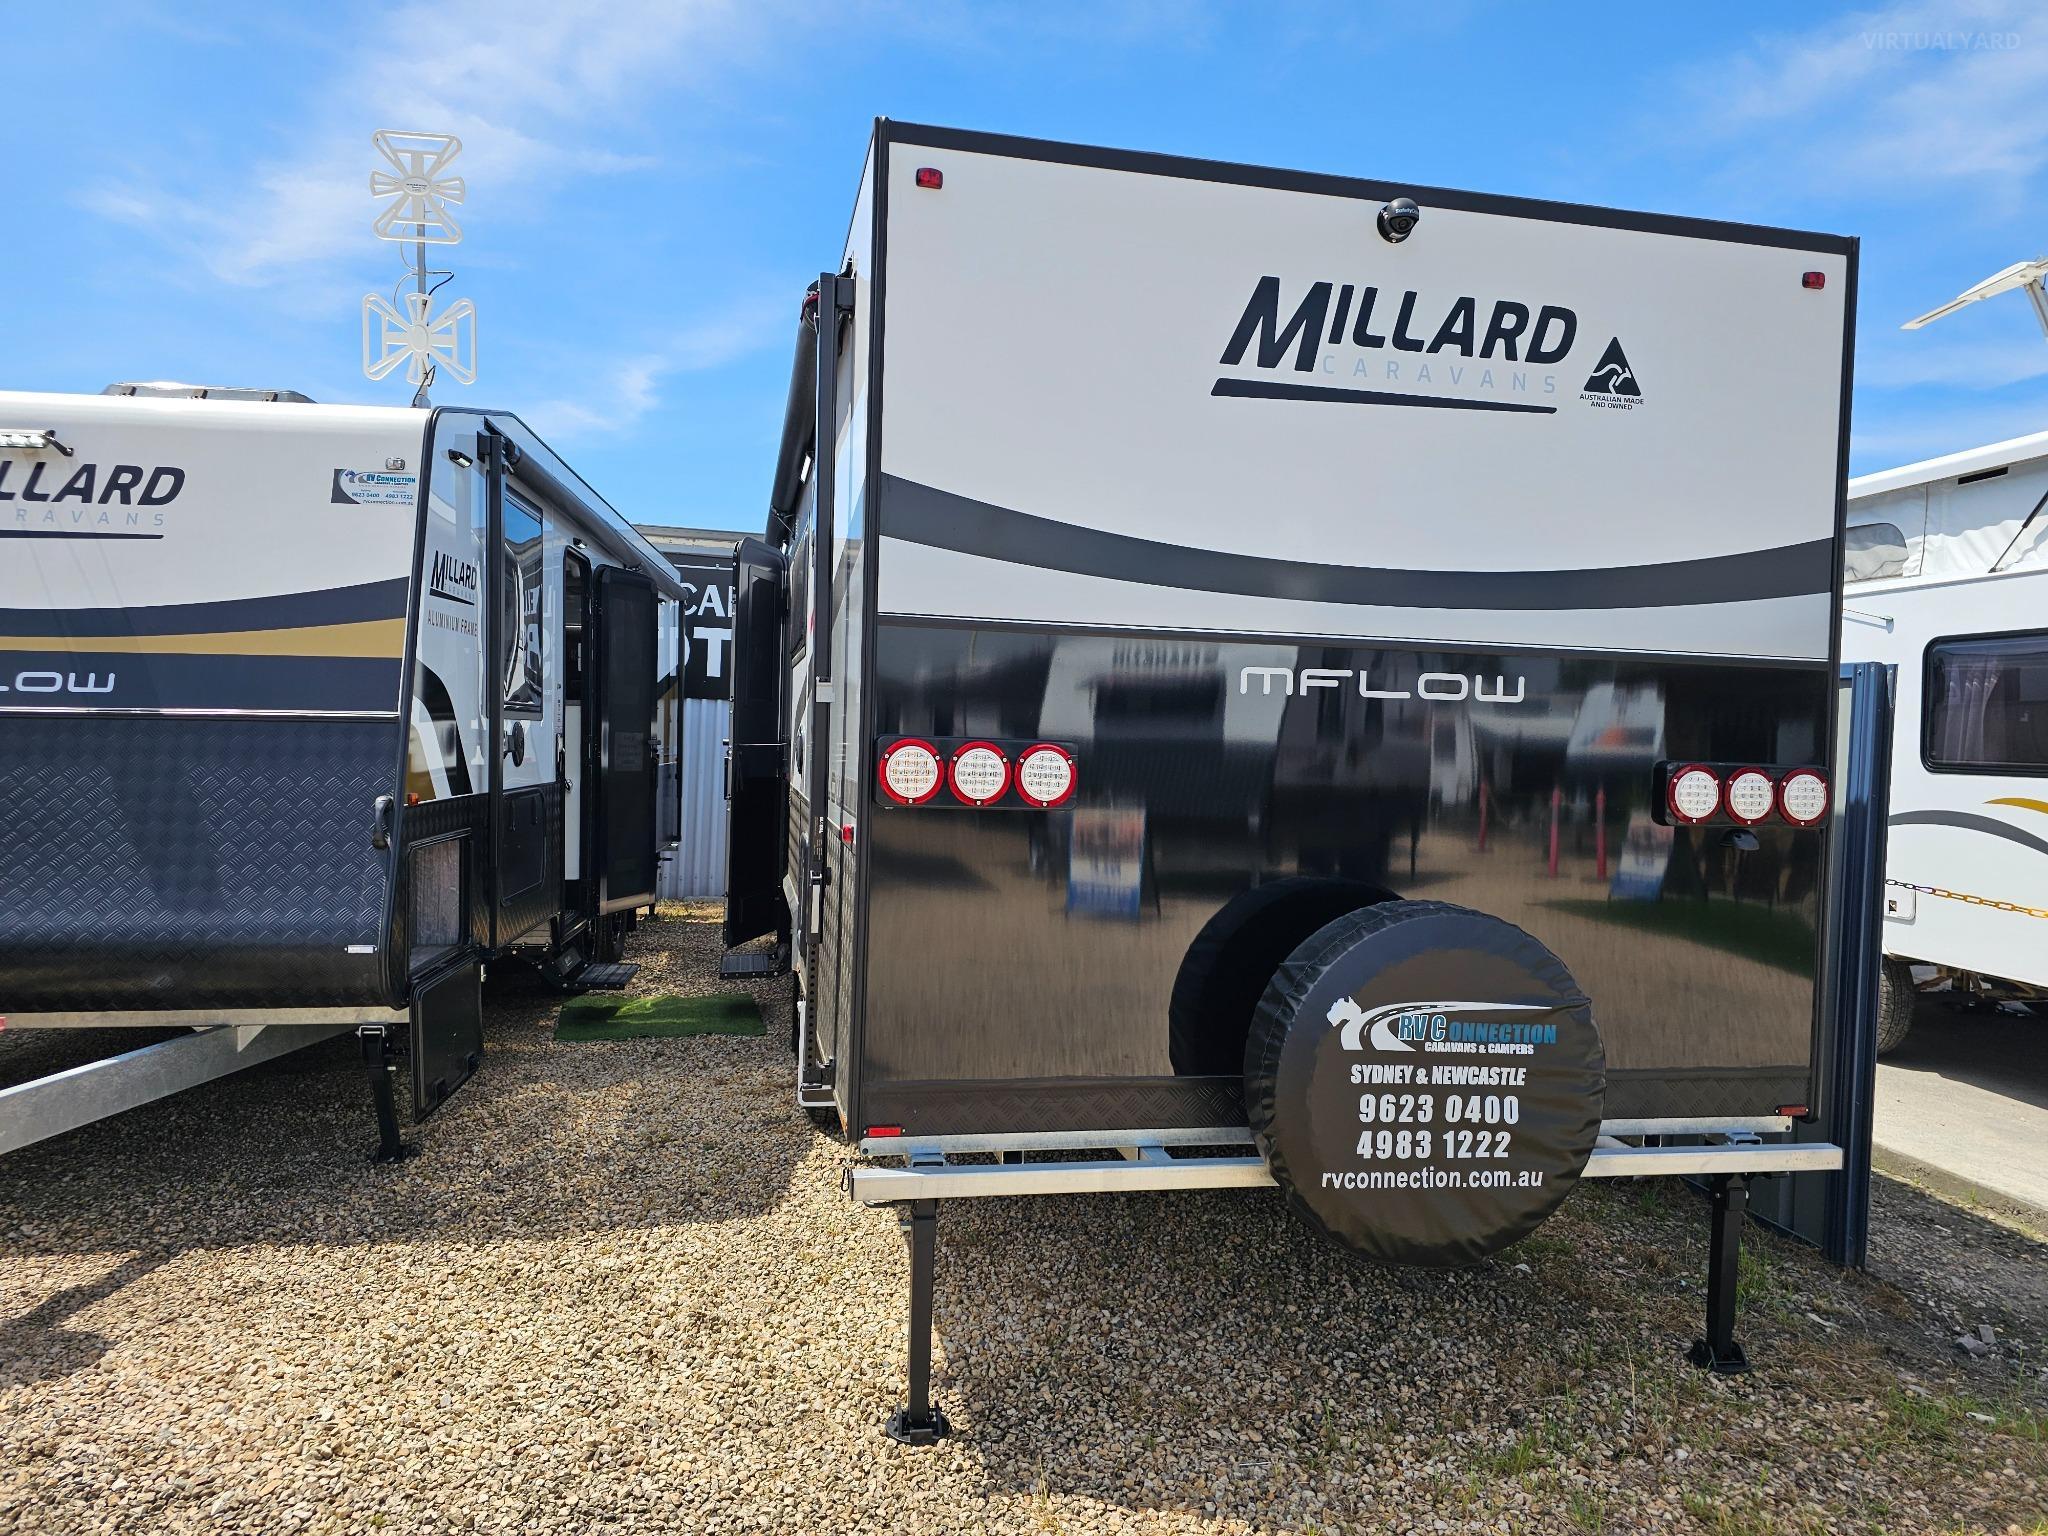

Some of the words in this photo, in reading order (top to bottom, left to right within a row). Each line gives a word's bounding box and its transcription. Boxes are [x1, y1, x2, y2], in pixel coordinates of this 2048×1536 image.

[1219, 276, 1578, 372] MILLARD
[1322, 354, 1556, 394] CARAVANS
[1579, 393, 1622, 403] AUSTRALIAN
[1623, 397, 1645, 405] MADE
[1607, 402, 1633, 410] OWNED
[15, 508, 165, 526] RAVANS
[430, 550, 478, 590] MILLARD
[680, 582, 733, 617] CA
[460, 618, 478, 637] FRAME
[0, 671, 116, 693] OW
[1239, 666, 1525, 703] MFLOW
[1424, 1041, 1477, 1054] CARAVANS
[1478, 1044, 1487, 1054] &
[1487, 1043, 1534, 1055] CAMPERS
[1350, 1064, 1414, 1085] SYDNEY
[1415, 1067, 1429, 1085] &
[1431, 1065, 1527, 1086] NEWCASTLE
[1359, 1093, 1434, 1123] 9623
[1444, 1095, 1519, 1125] 0400
[1356, 1130, 1432, 1159] 4983
[1442, 1130, 1512, 1159] 1222
[1321, 1166, 1543, 1189] rvconnection.com.au
